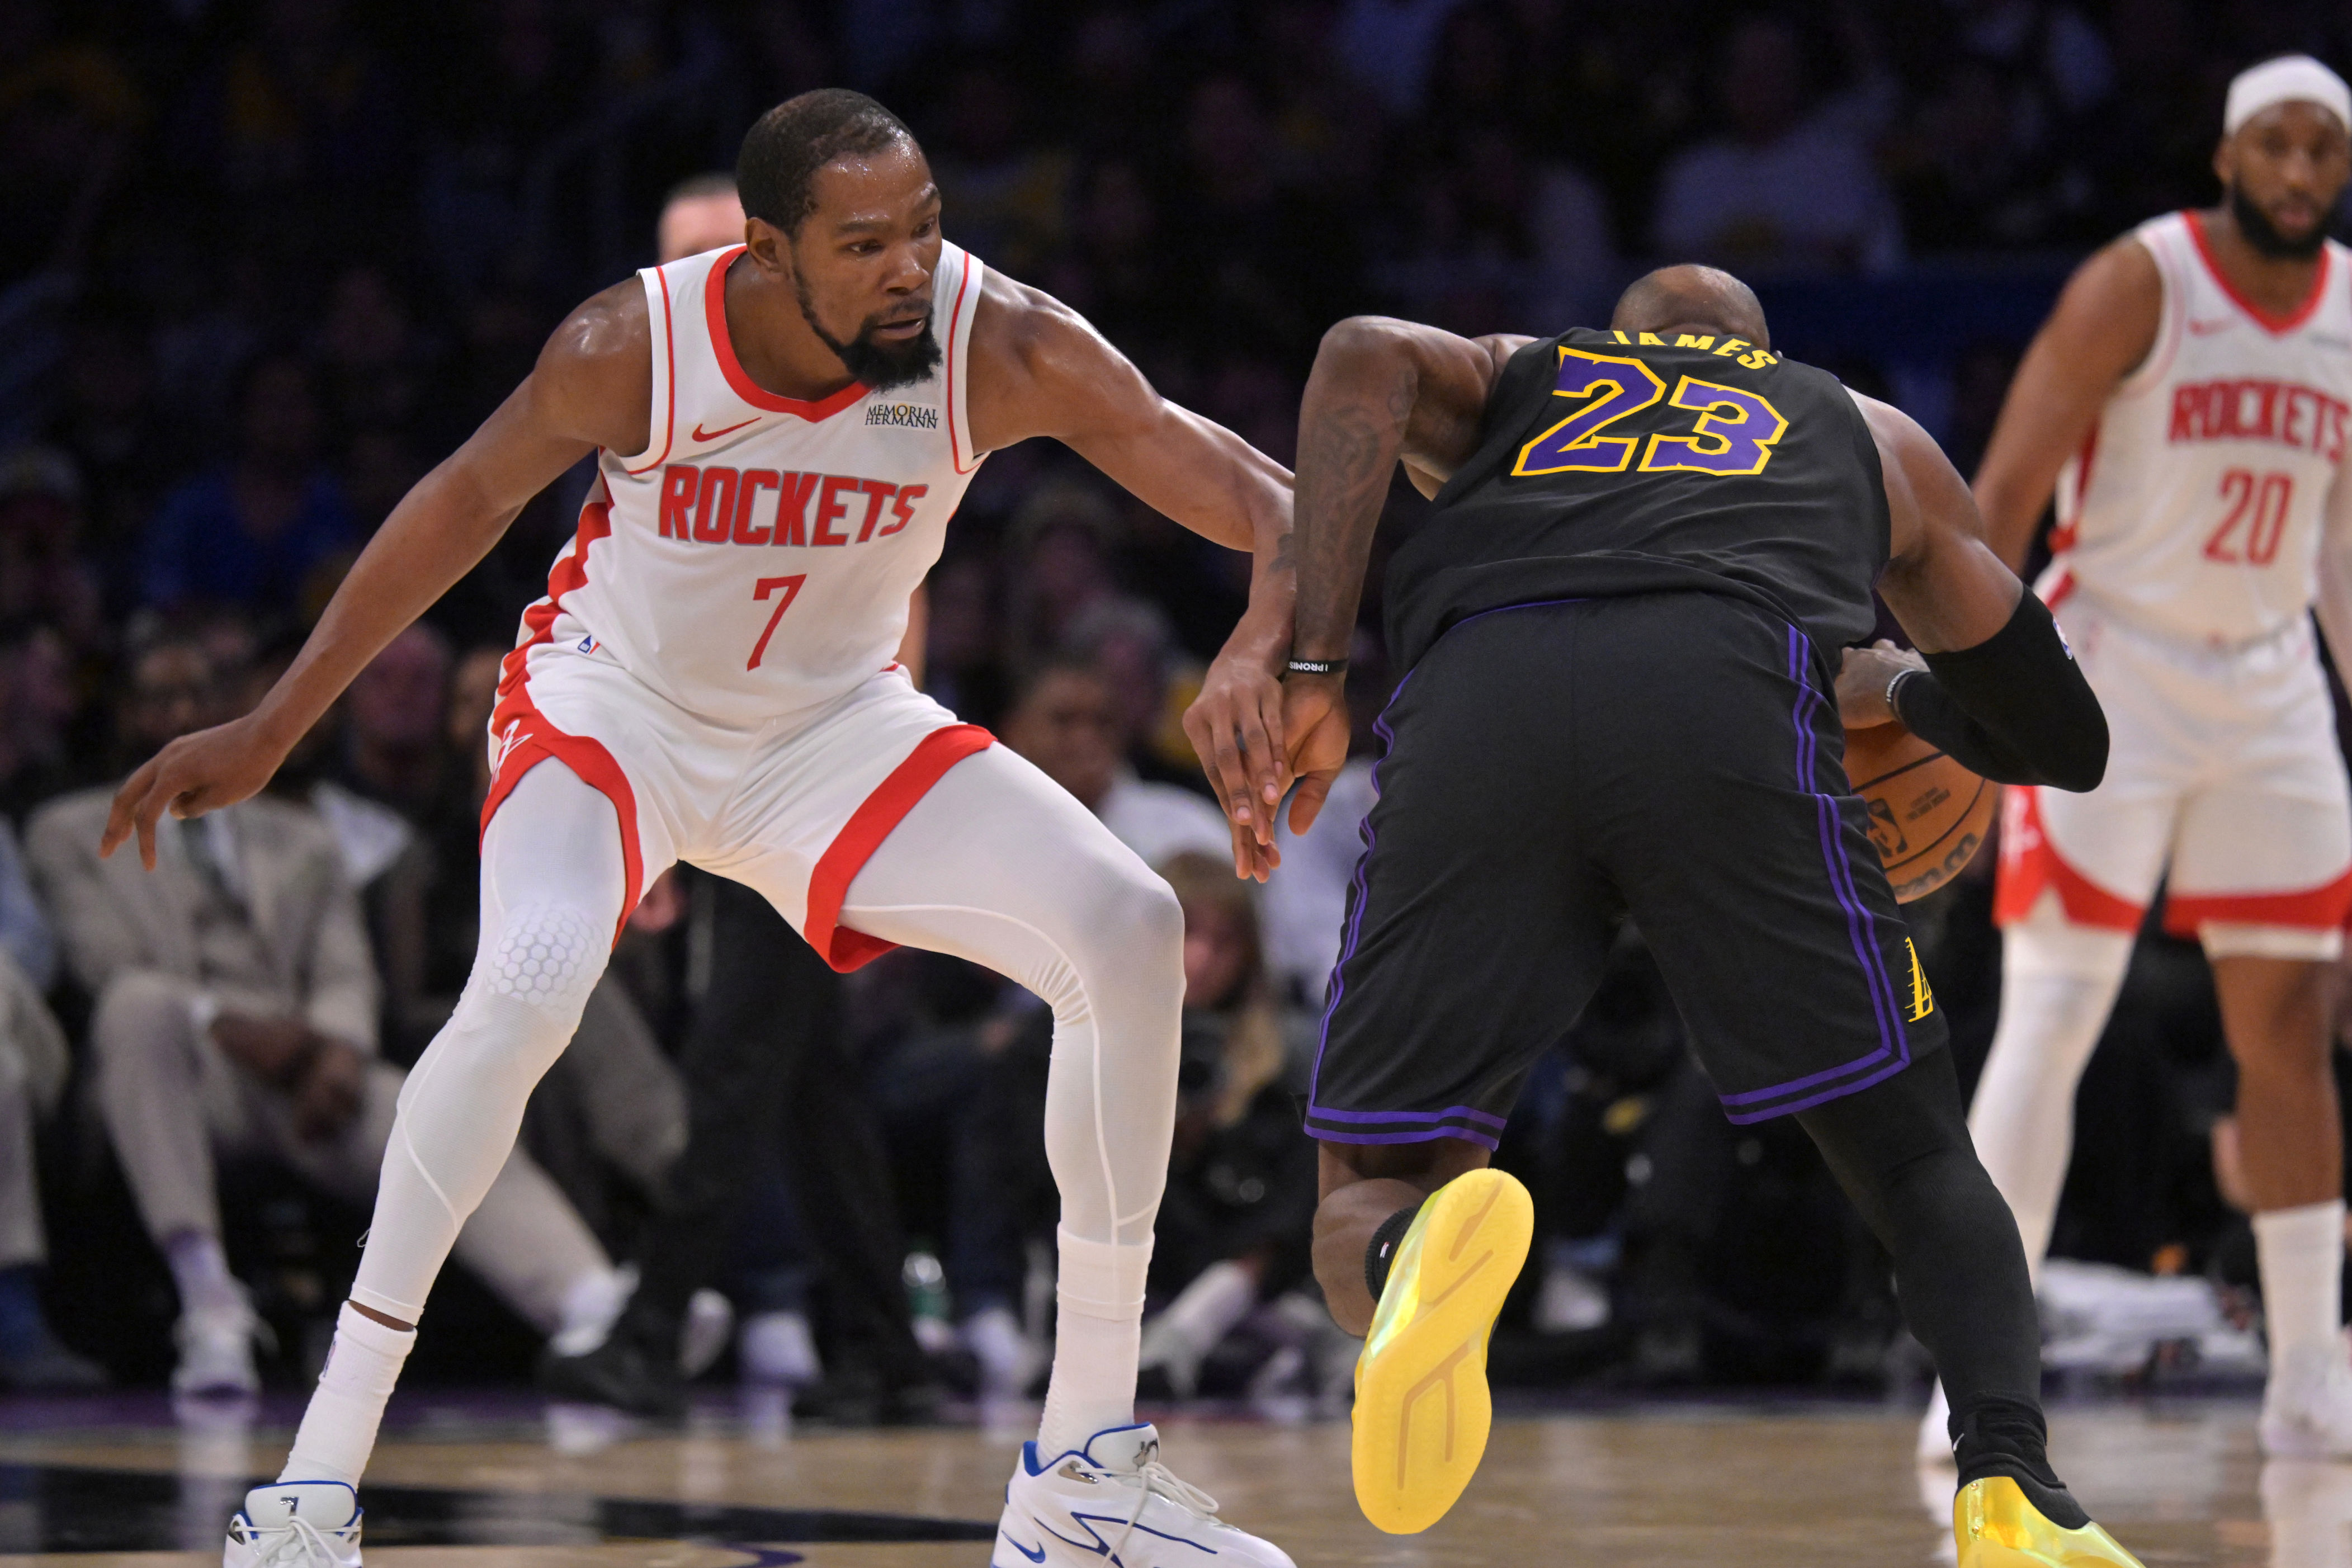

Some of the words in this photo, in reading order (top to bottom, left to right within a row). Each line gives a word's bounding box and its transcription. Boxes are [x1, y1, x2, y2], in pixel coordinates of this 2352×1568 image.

[1607, 330, 1778, 369] JAMES
[865, 414, 938, 429] HERMANN
[867, 404, 938, 419] MEMORIAL
[1510, 346, 1789, 476] 23
[2168, 378, 2351, 465] ROCKETS
[658, 464, 929, 547] ROCKETS
[2202, 467, 2294, 566] 20
[747, 573, 807, 671] 7
[1289, 661, 1324, 672] PROMIS
